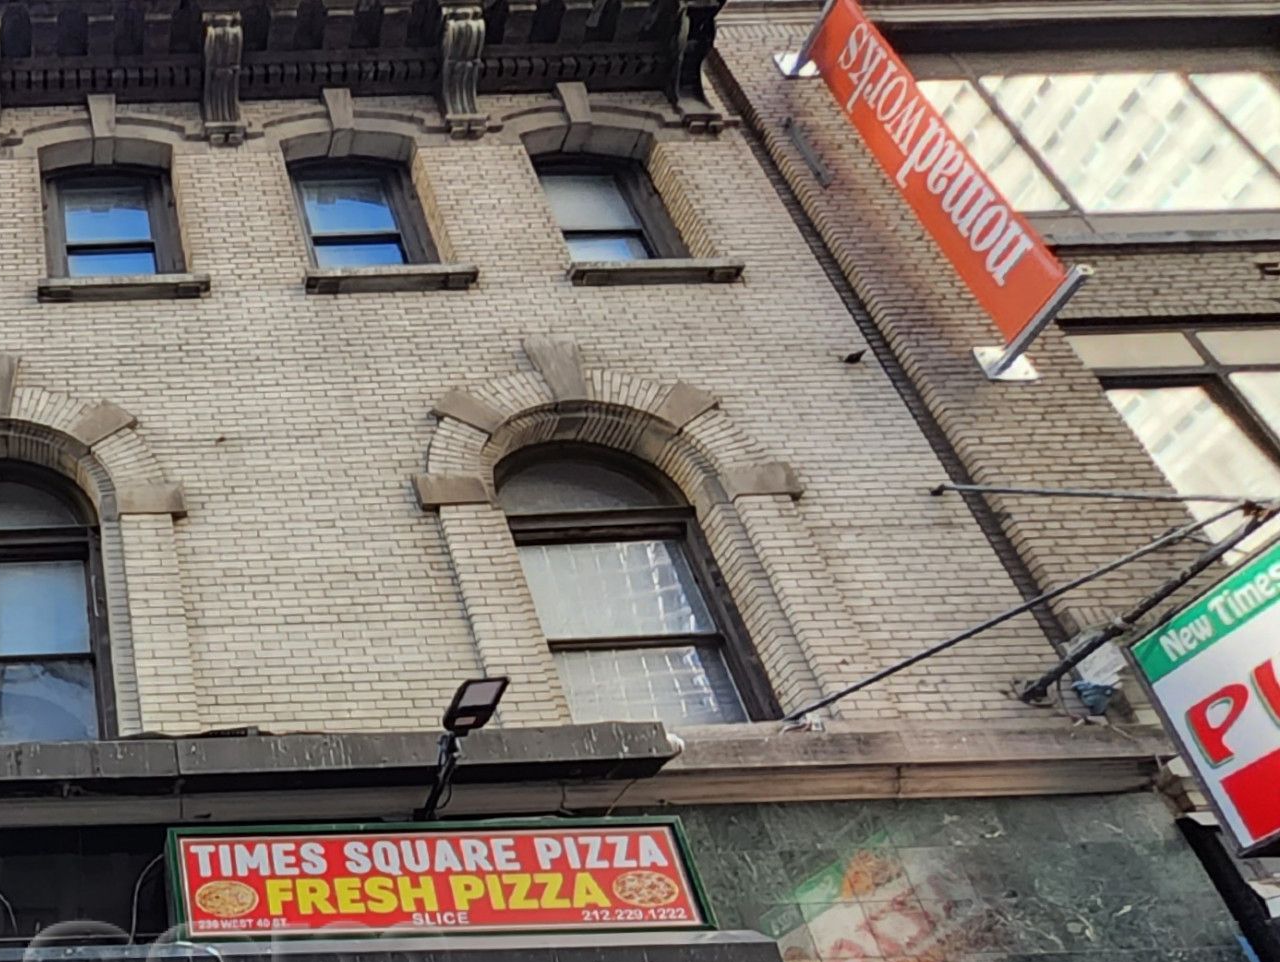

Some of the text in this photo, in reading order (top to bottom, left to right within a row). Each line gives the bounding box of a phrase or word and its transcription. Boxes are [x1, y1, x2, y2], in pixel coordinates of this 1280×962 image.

[837, 22, 1034, 287] nomadworks
[1160, 614, 1214, 662] New
[189, 835, 669, 877] TIMES SQUARE PIZZA
[265, 872, 612, 916] FRESH PIZZA
[221, 918, 254, 929] WEST
[412, 912, 469, 926] SLICE
